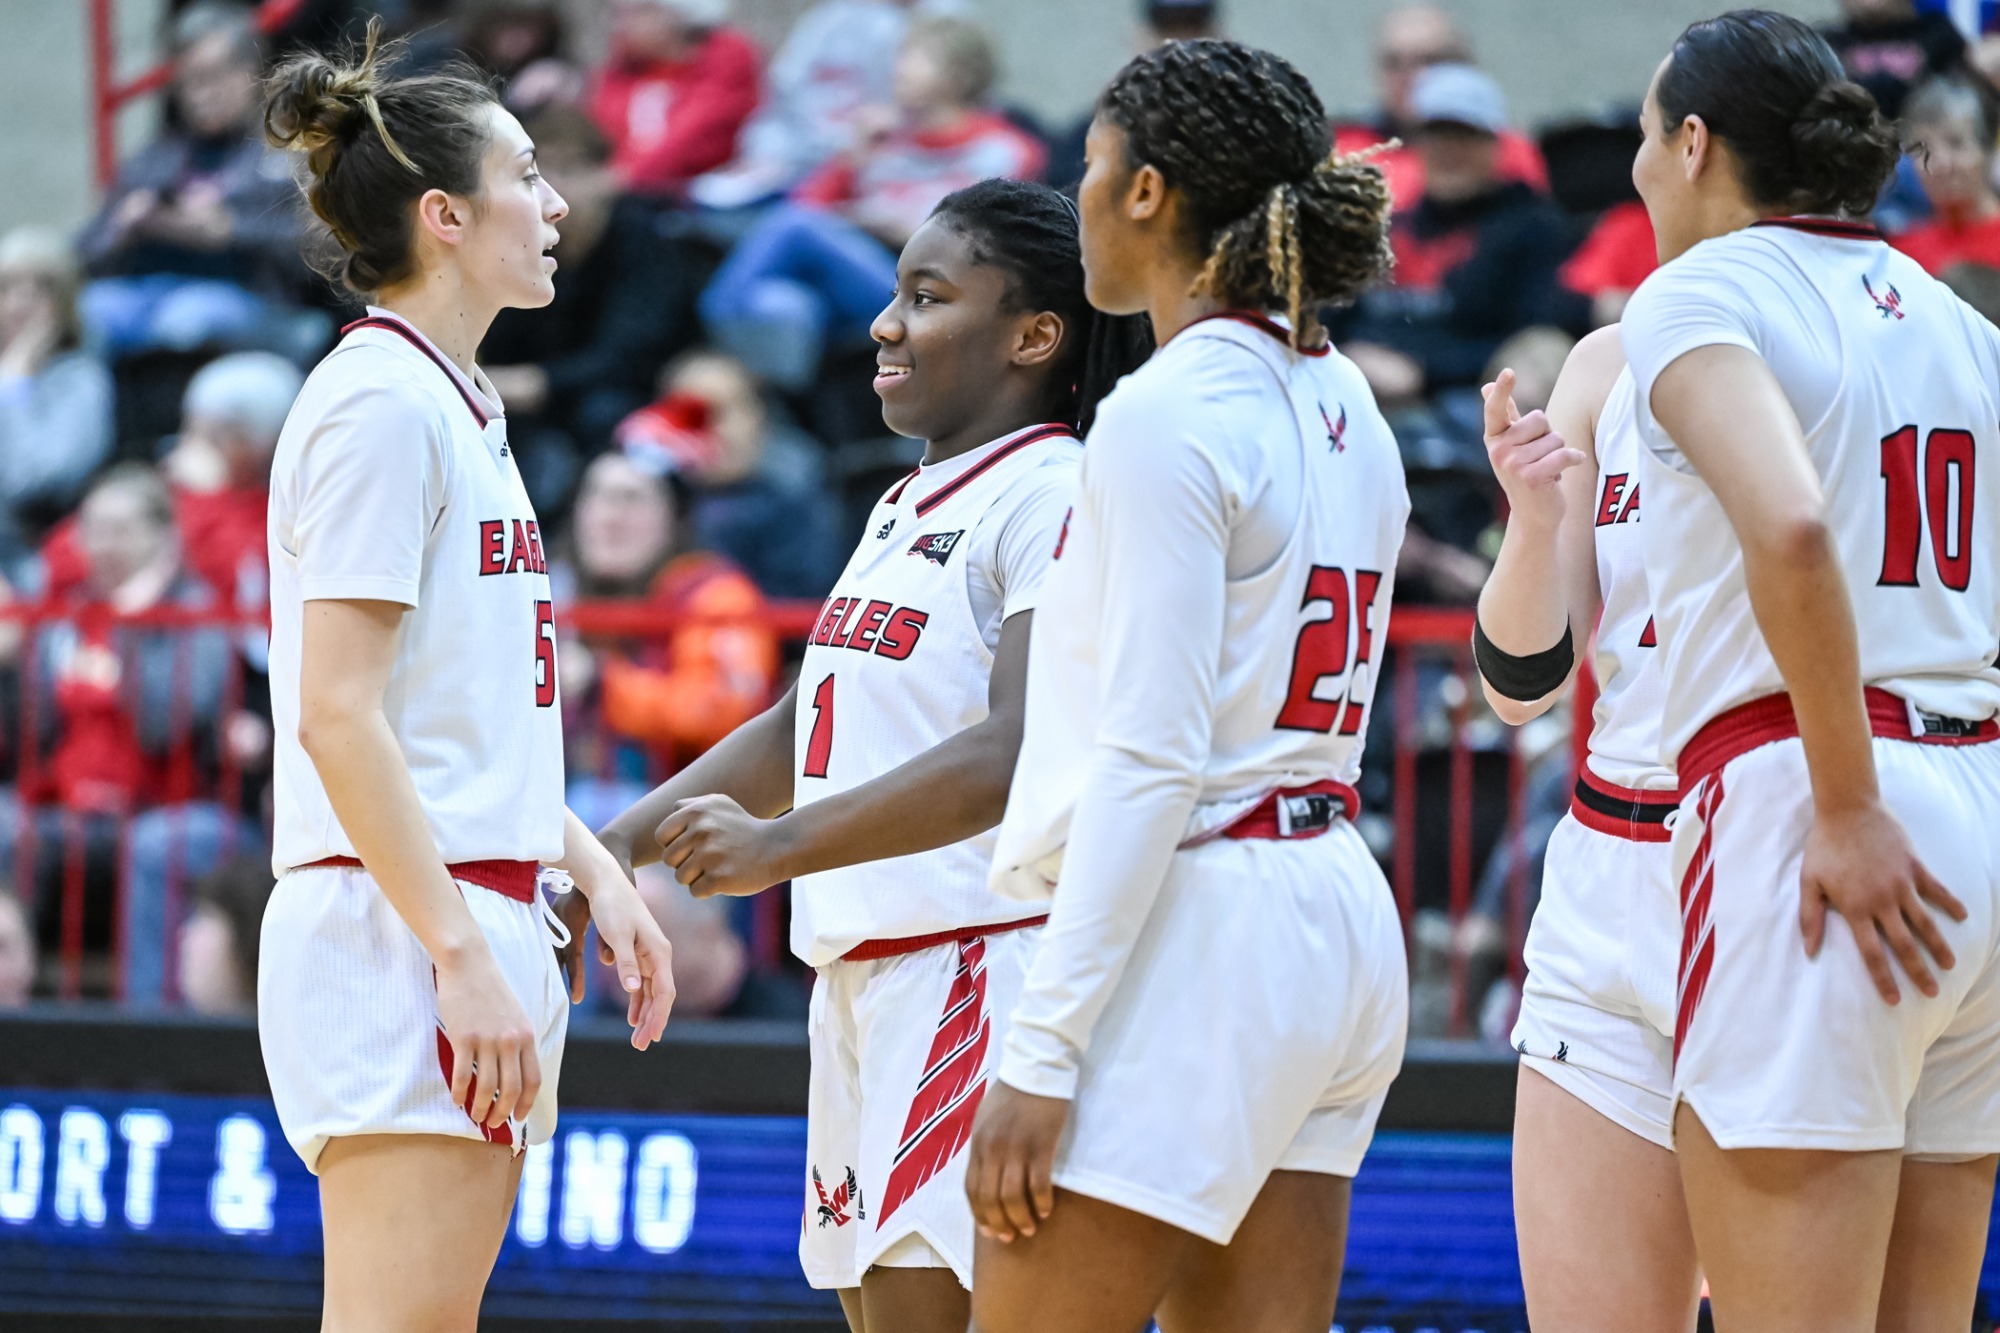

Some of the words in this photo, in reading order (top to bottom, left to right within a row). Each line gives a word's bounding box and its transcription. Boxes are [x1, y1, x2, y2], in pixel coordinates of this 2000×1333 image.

[1876, 424, 1975, 592] 10
[534, 599, 555, 707] 5
[808, 596, 929, 661] GLES
[1273, 564, 1382, 736] 25
[803, 672, 835, 779] 1
[0, 1104, 173, 1230] ORT
[208, 1113, 277, 1235] &
